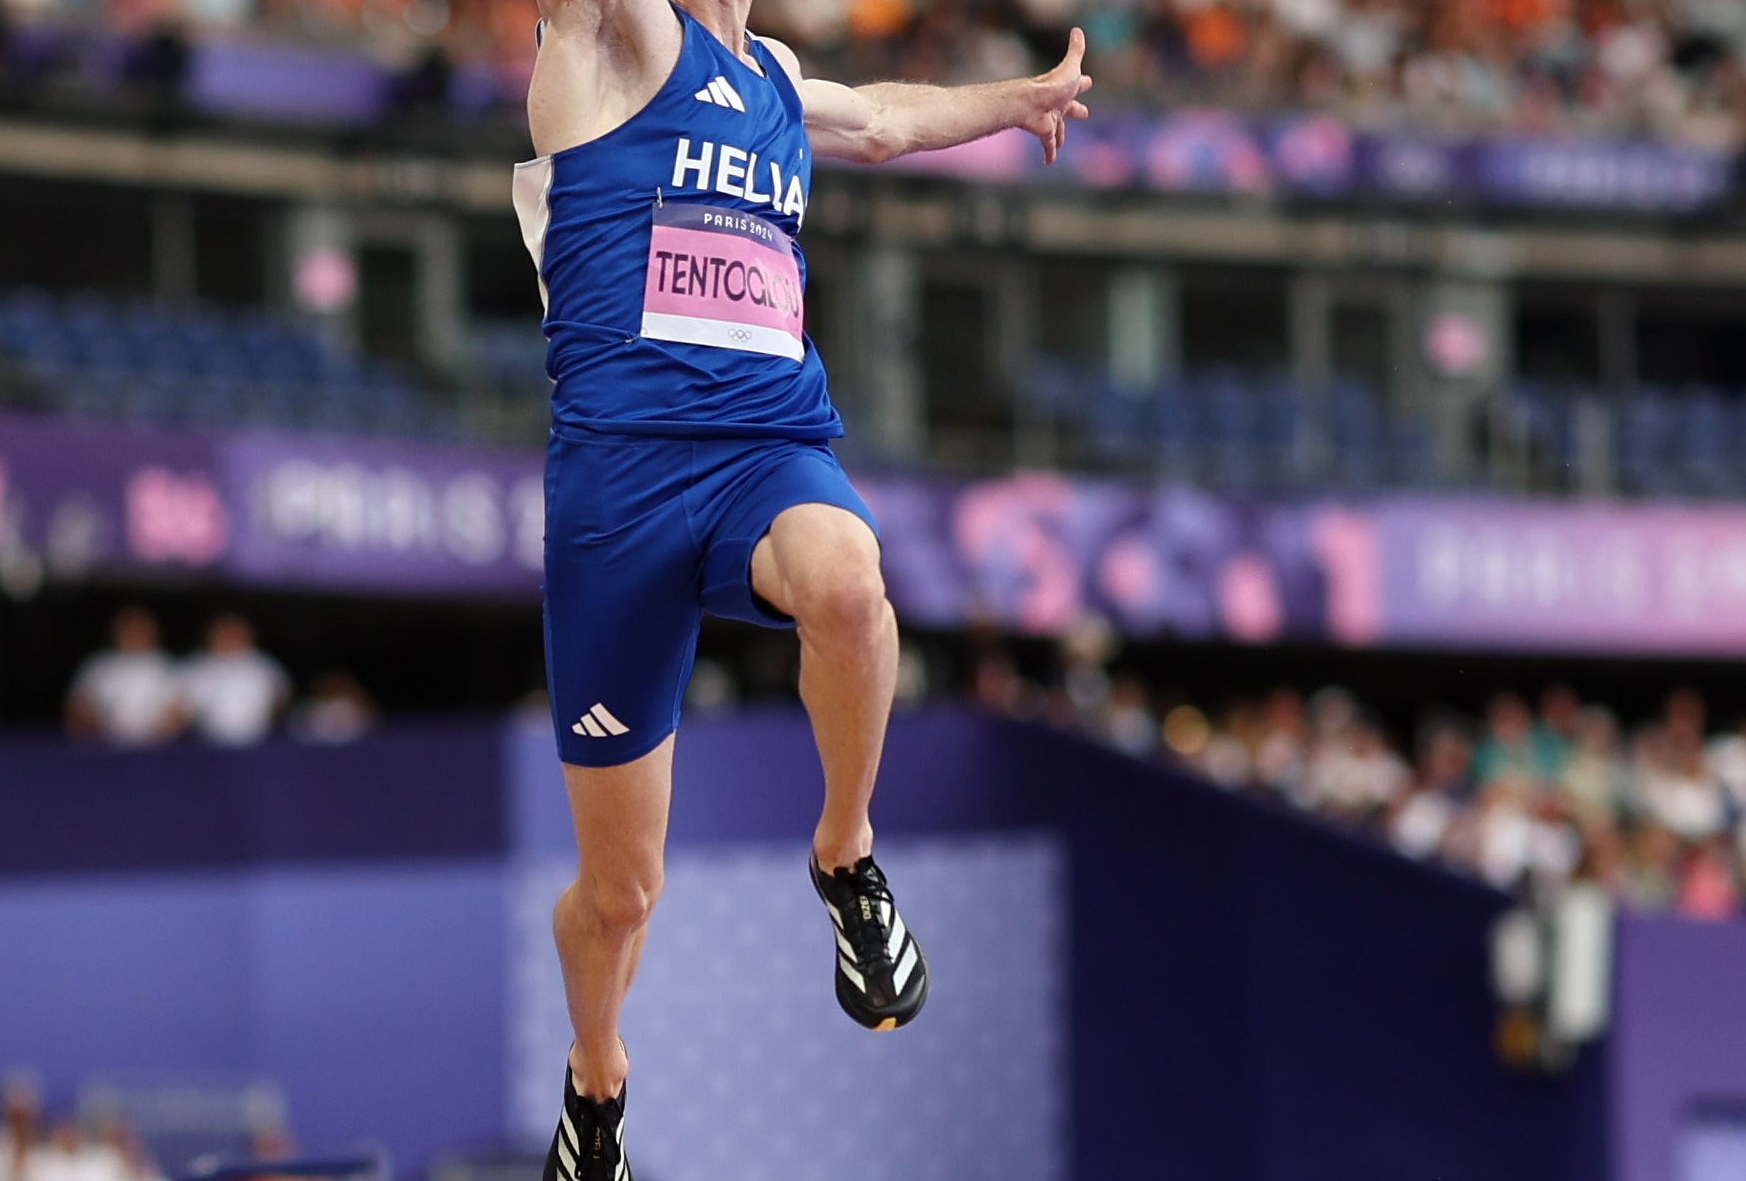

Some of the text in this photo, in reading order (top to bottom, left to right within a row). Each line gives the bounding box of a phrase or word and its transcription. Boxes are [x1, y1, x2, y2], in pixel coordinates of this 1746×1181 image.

[671, 137, 808, 234] HELLA
[703, 212, 773, 242] PARIS 2024
[655, 250, 801, 318] TENTOGLOU
[269, 458, 504, 564] PARIS
